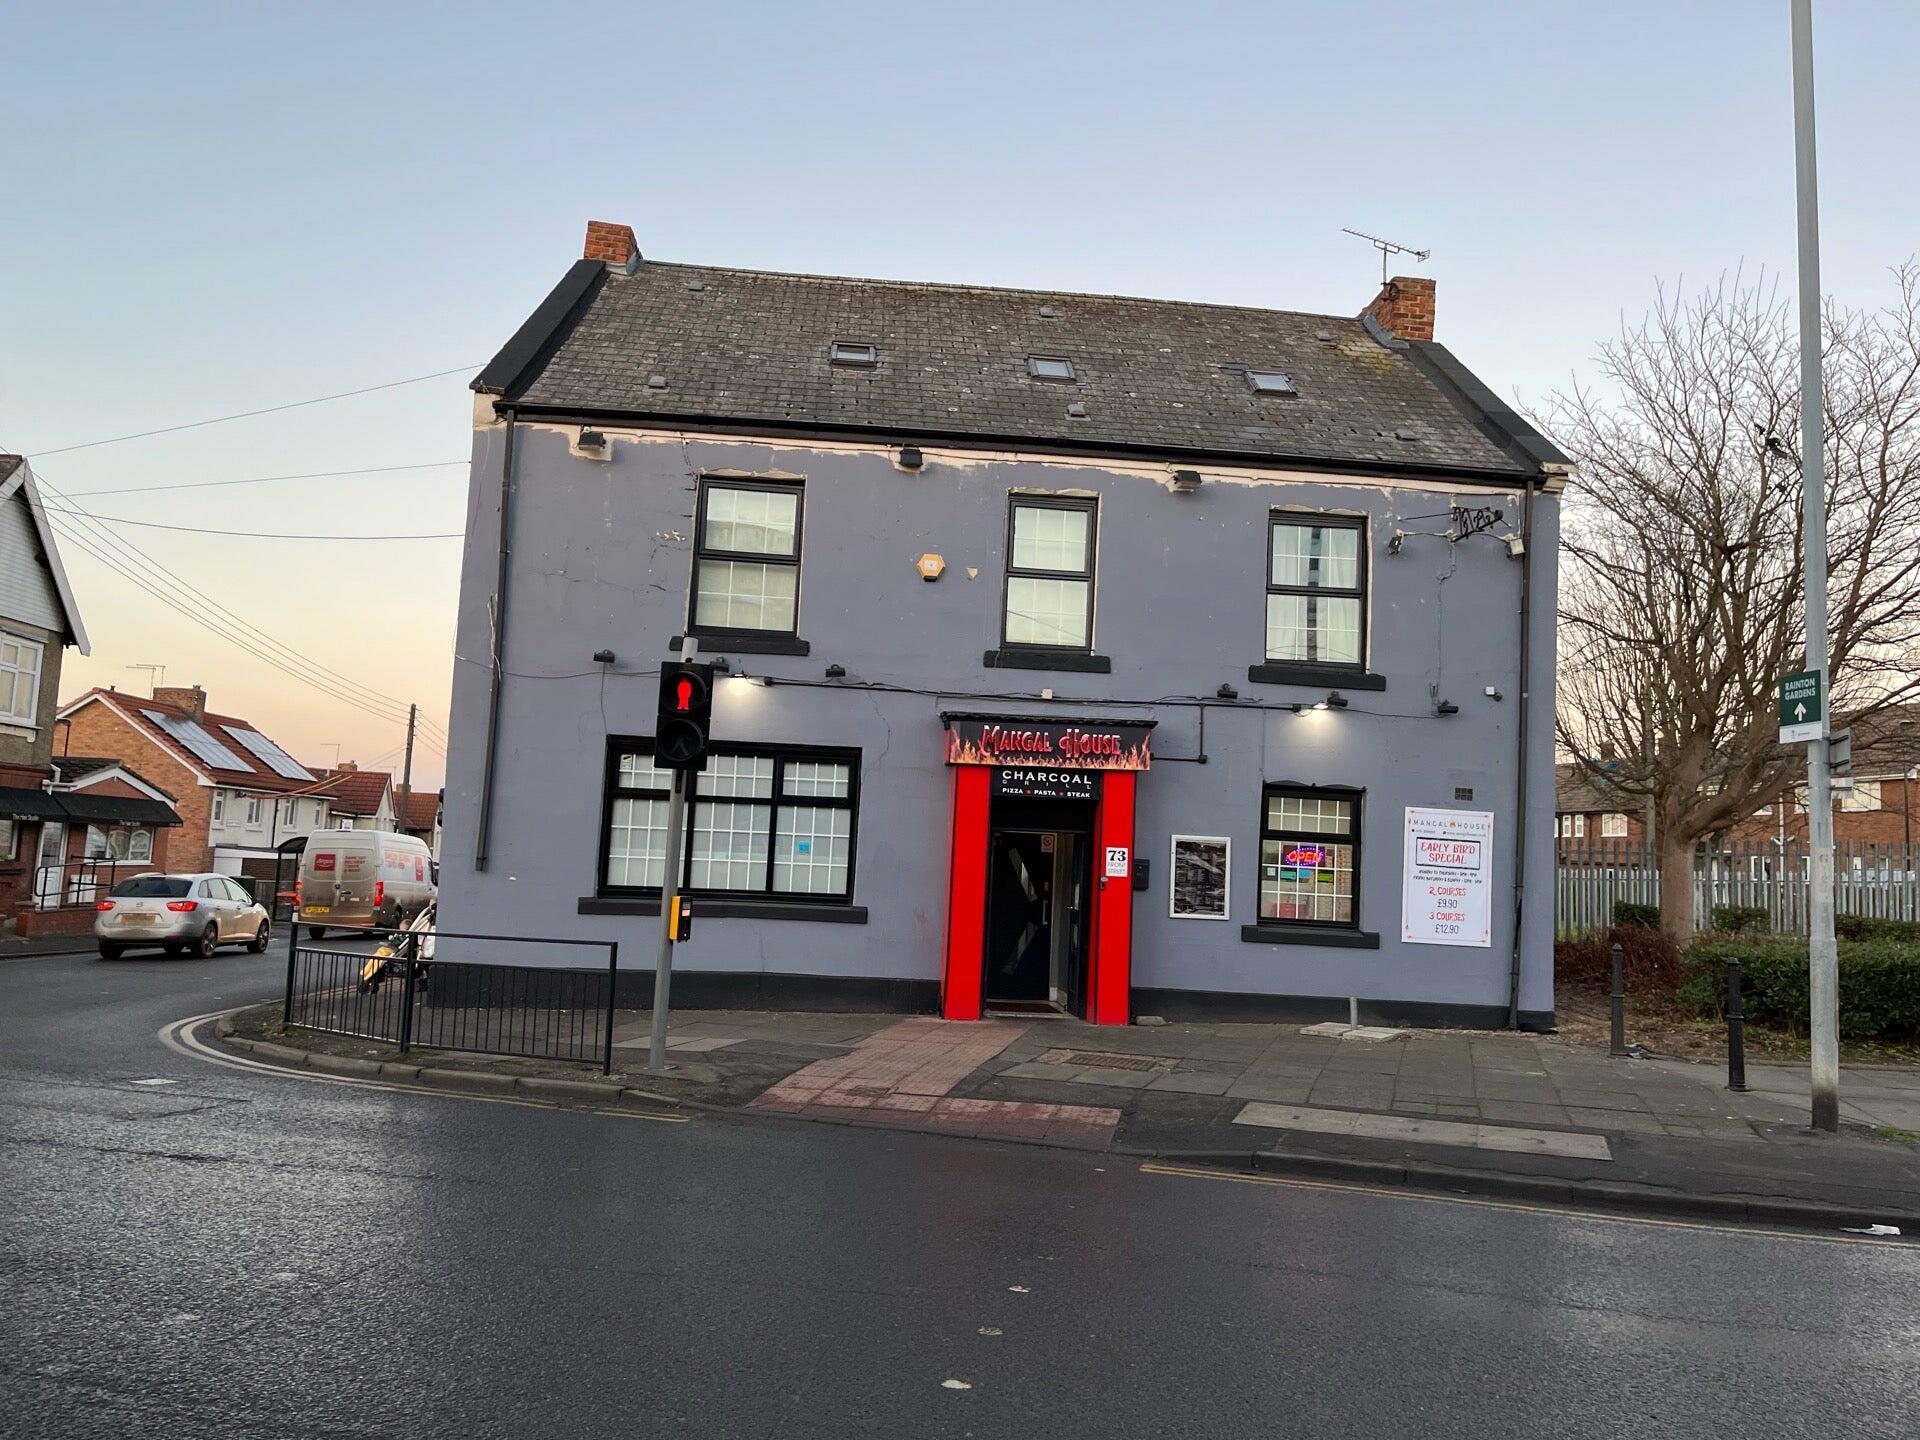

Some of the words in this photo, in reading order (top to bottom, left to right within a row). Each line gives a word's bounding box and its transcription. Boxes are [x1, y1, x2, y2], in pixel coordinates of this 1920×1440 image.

[1785, 678, 1815, 690] RAINTON
[1785, 688, 1815, 700] GARDENS
[980, 725, 1053, 756] MANGAL
[1058, 728, 1121, 758] HOUSE
[1002, 770, 1092, 785] CHARCOAL
[1002, 787, 1023, 795] PIZZA
[1034, 789, 1056, 797] PASTA
[1067, 791, 1090, 799] STEAK
[1413, 819, 1448, 828] MANGAL
[1457, 822, 1486, 830] HOUSE
[1420, 842, 1449, 853] EARLY
[1453, 843, 1476, 854] BIRD
[1108, 850, 1126, 861] 73
[1288, 851, 1322, 862] OPEN
[1428, 853, 1466, 864] SPECIAL
[1428, 886, 1435, 895] 2
[1437, 887, 1466, 896] COURSES
[1437, 898, 1457, 908] £9.90
[1429, 911, 1435, 920] 3
[1436, 912, 1466, 922] COURSES
[1435, 924, 1459, 934] £12.90
